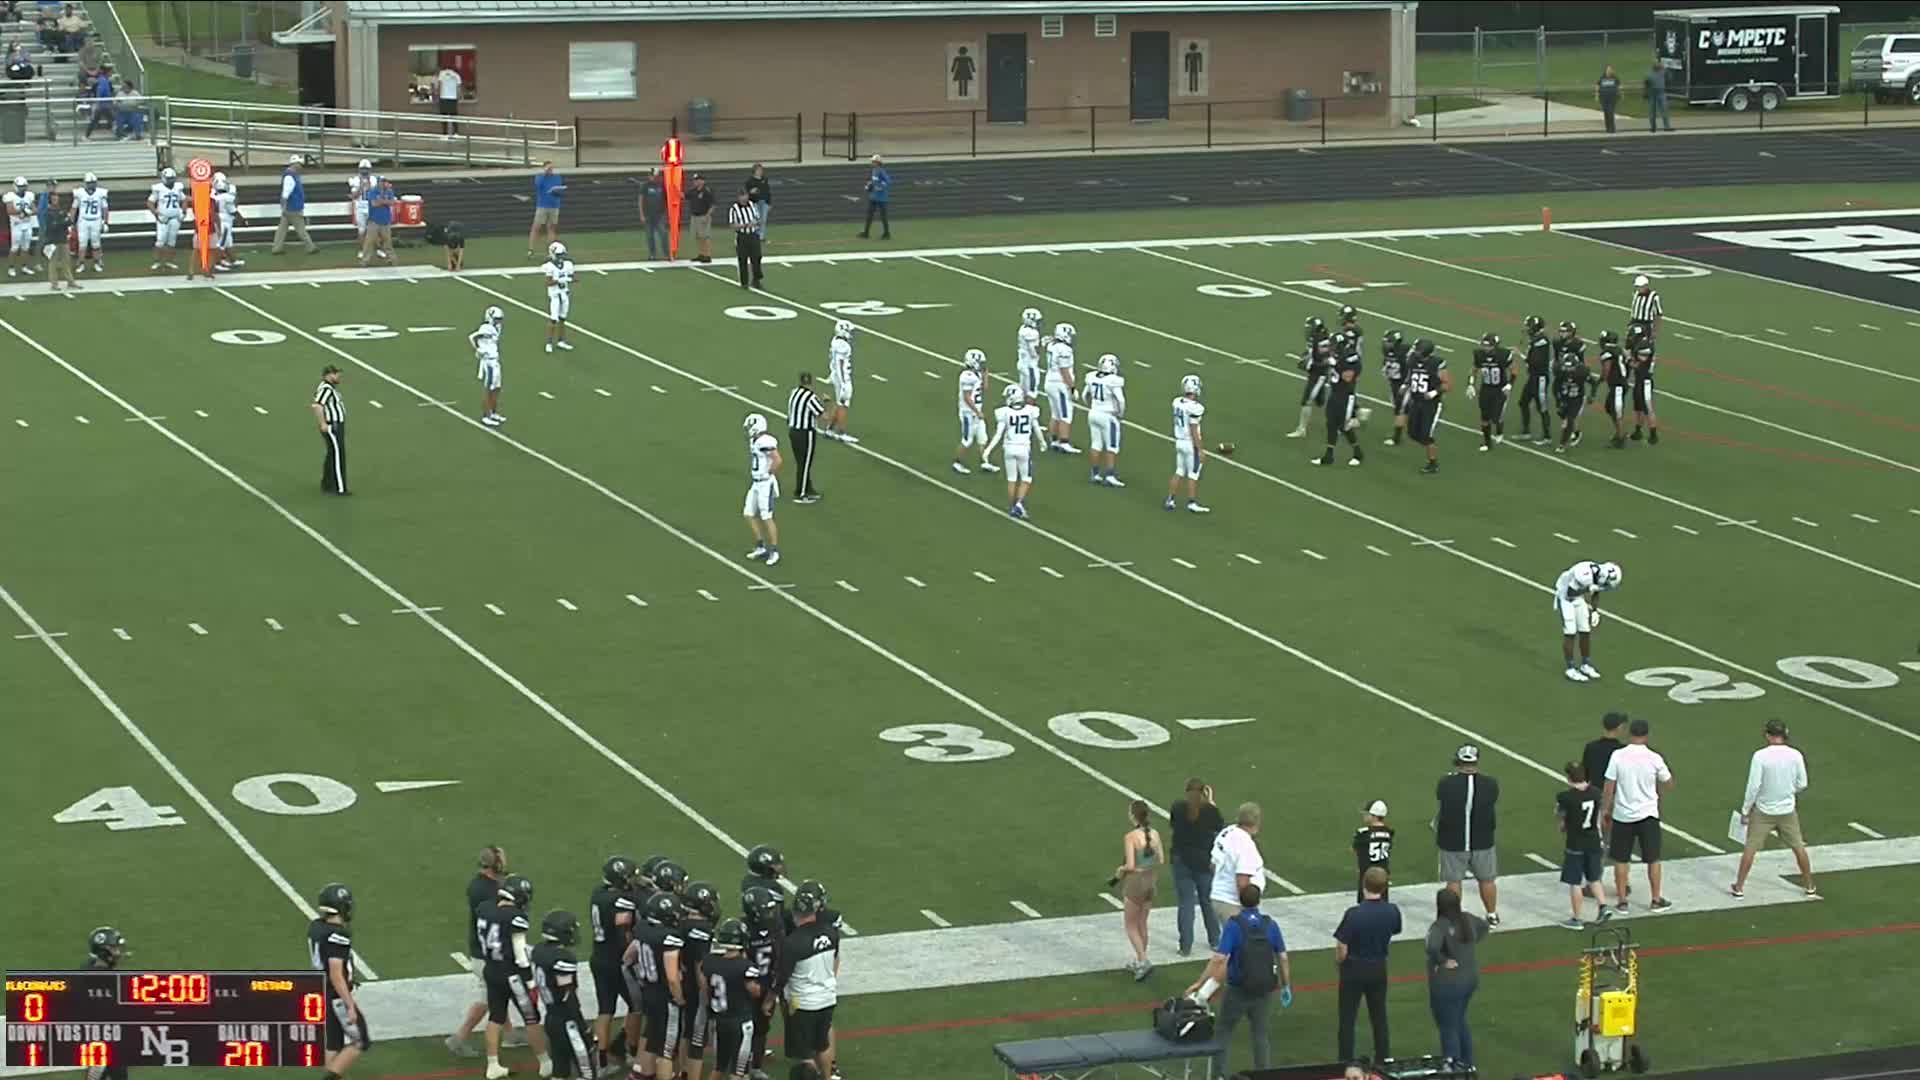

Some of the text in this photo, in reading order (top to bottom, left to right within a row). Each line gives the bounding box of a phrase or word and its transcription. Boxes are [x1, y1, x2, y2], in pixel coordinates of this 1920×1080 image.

[1092, 382, 1105, 402] 71
[1411, 373, 1429, 393] 65
[1009, 415, 1030, 434] 42
[1581, 800, 1595, 830] 7
